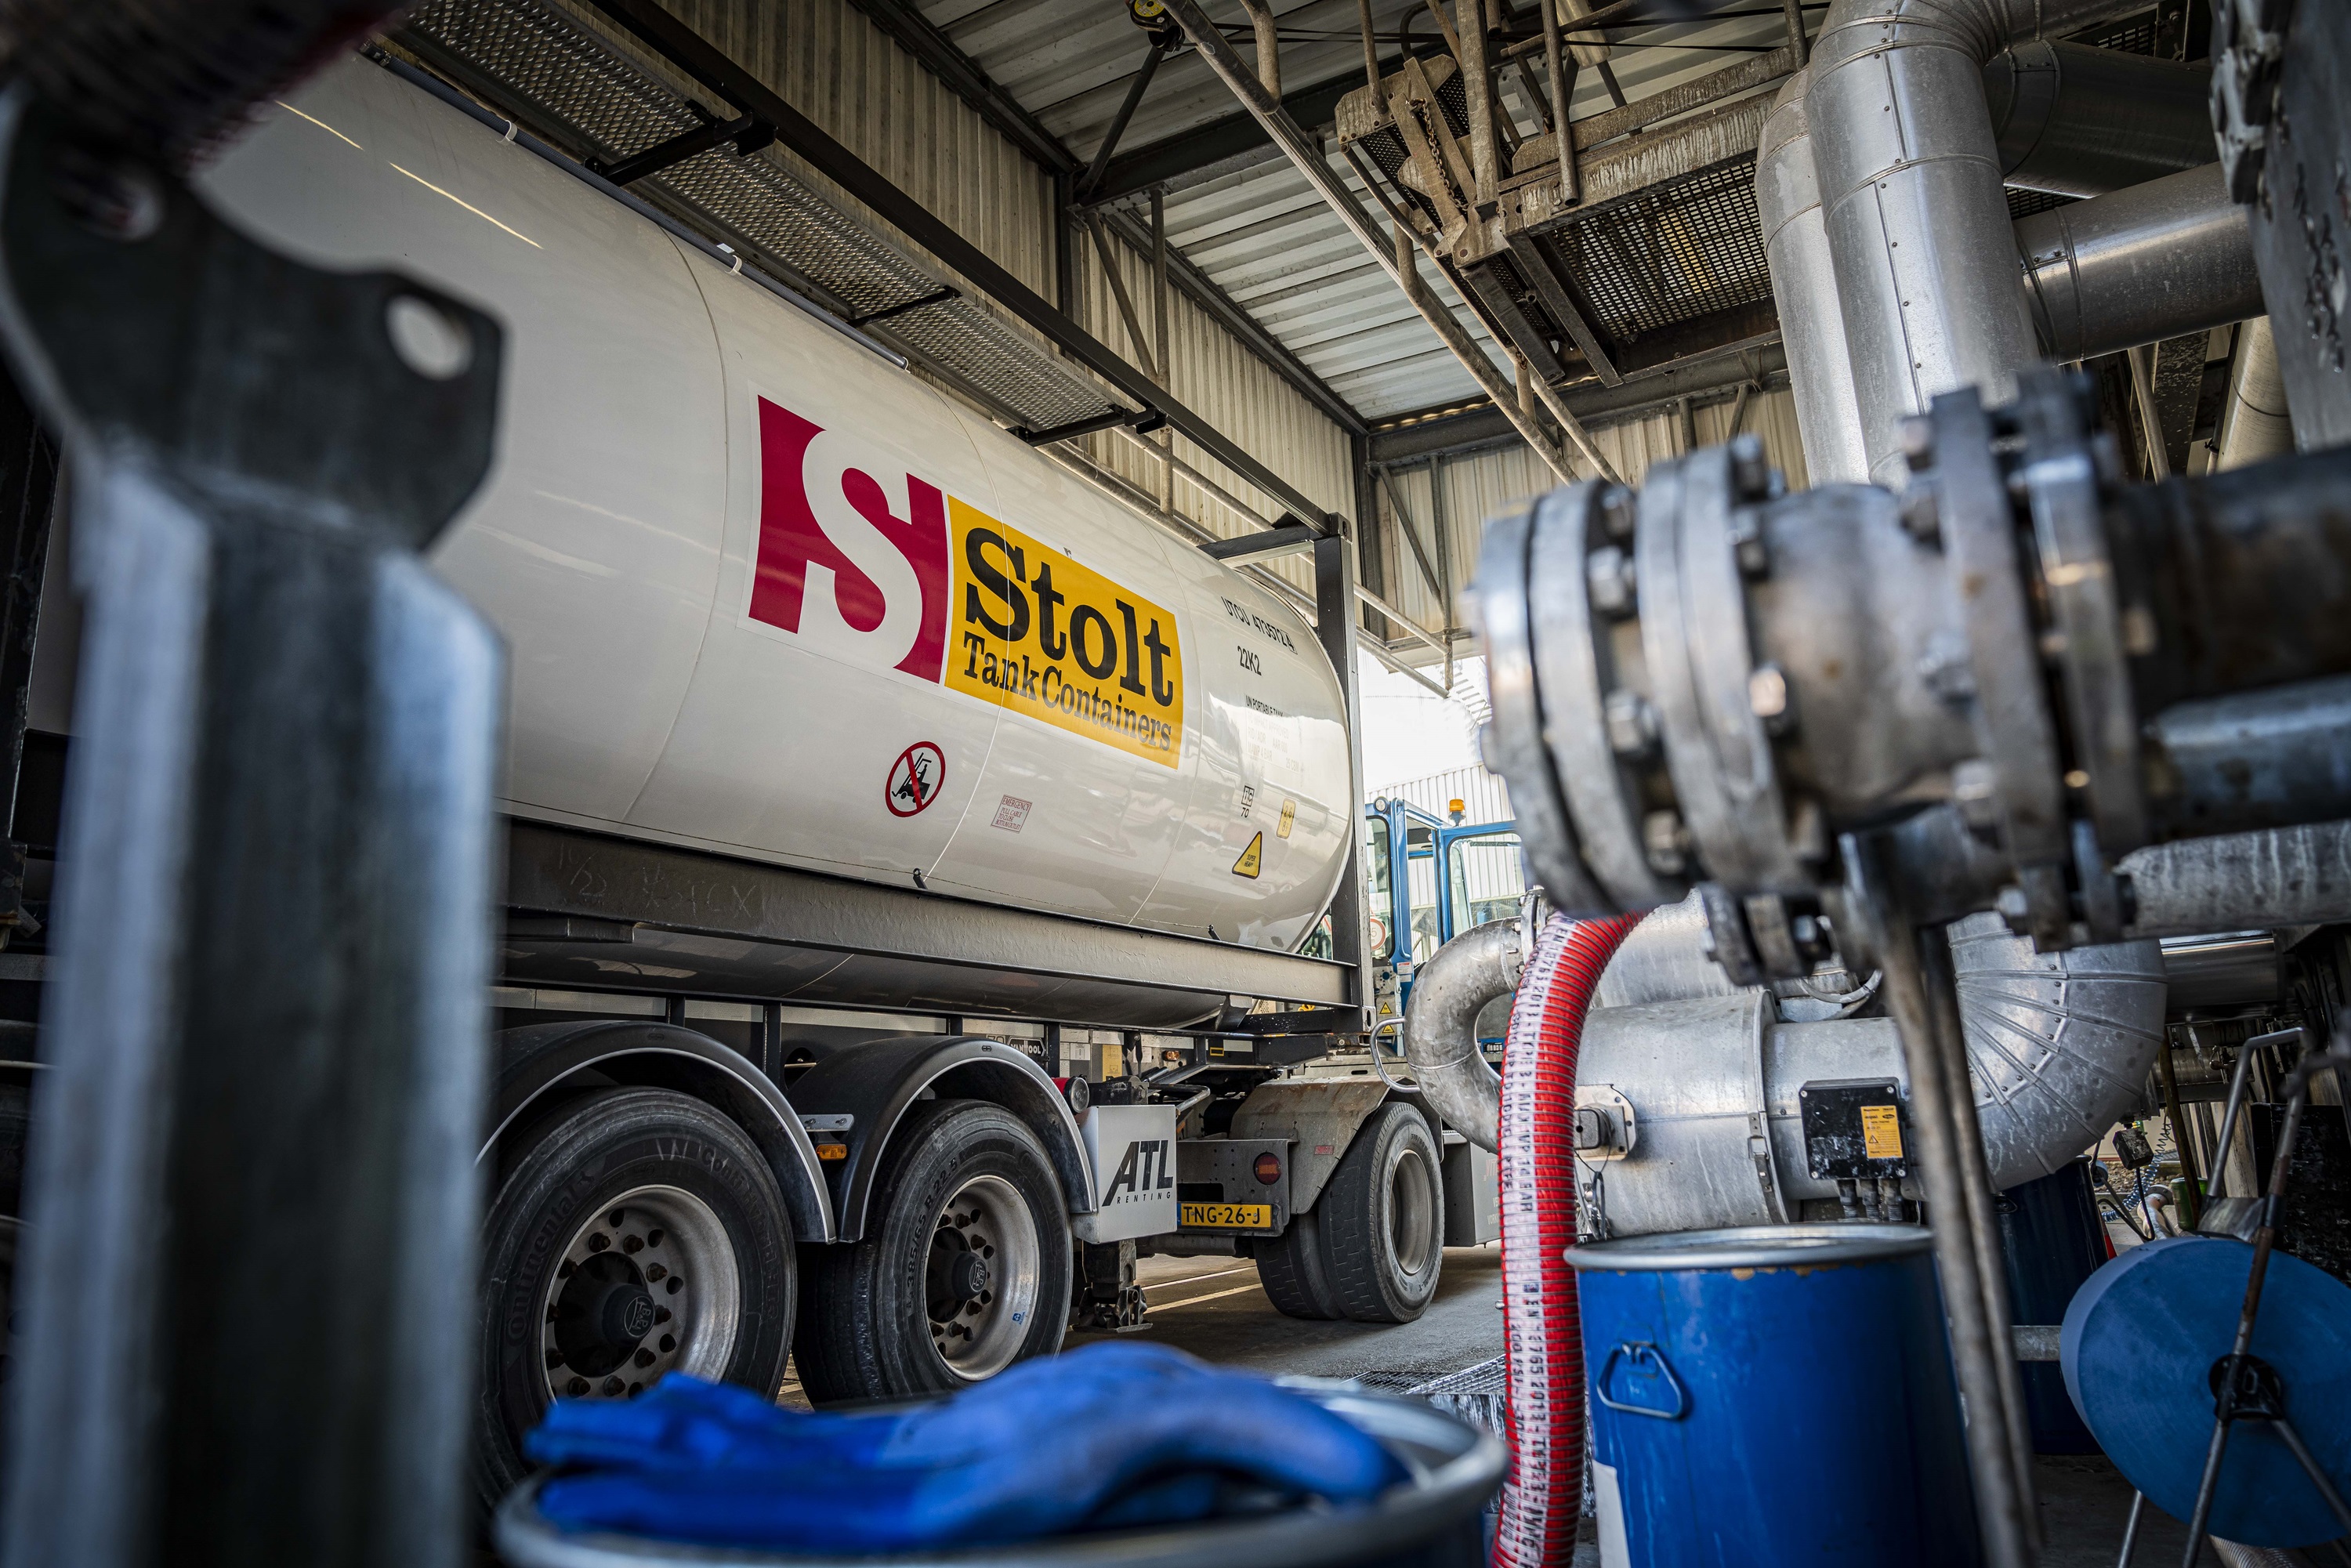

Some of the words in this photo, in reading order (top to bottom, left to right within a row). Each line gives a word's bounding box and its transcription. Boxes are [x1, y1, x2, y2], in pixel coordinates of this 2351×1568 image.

[965, 527, 1174, 708] Stolt
[1221, 596, 1251, 627] UTCU
[1237, 645, 1262, 676] 22K2
[1002, 797, 1030, 811] EMERGENCY
[1241, 807, 1249, 818] 70
[933, 1157, 958, 1192] 22.5
[1101, 1139, 1174, 1208] ATL
[1116, 1190, 1172, 1205] RENTING
[1183, 1206, 1260, 1225] TNG-26-J
